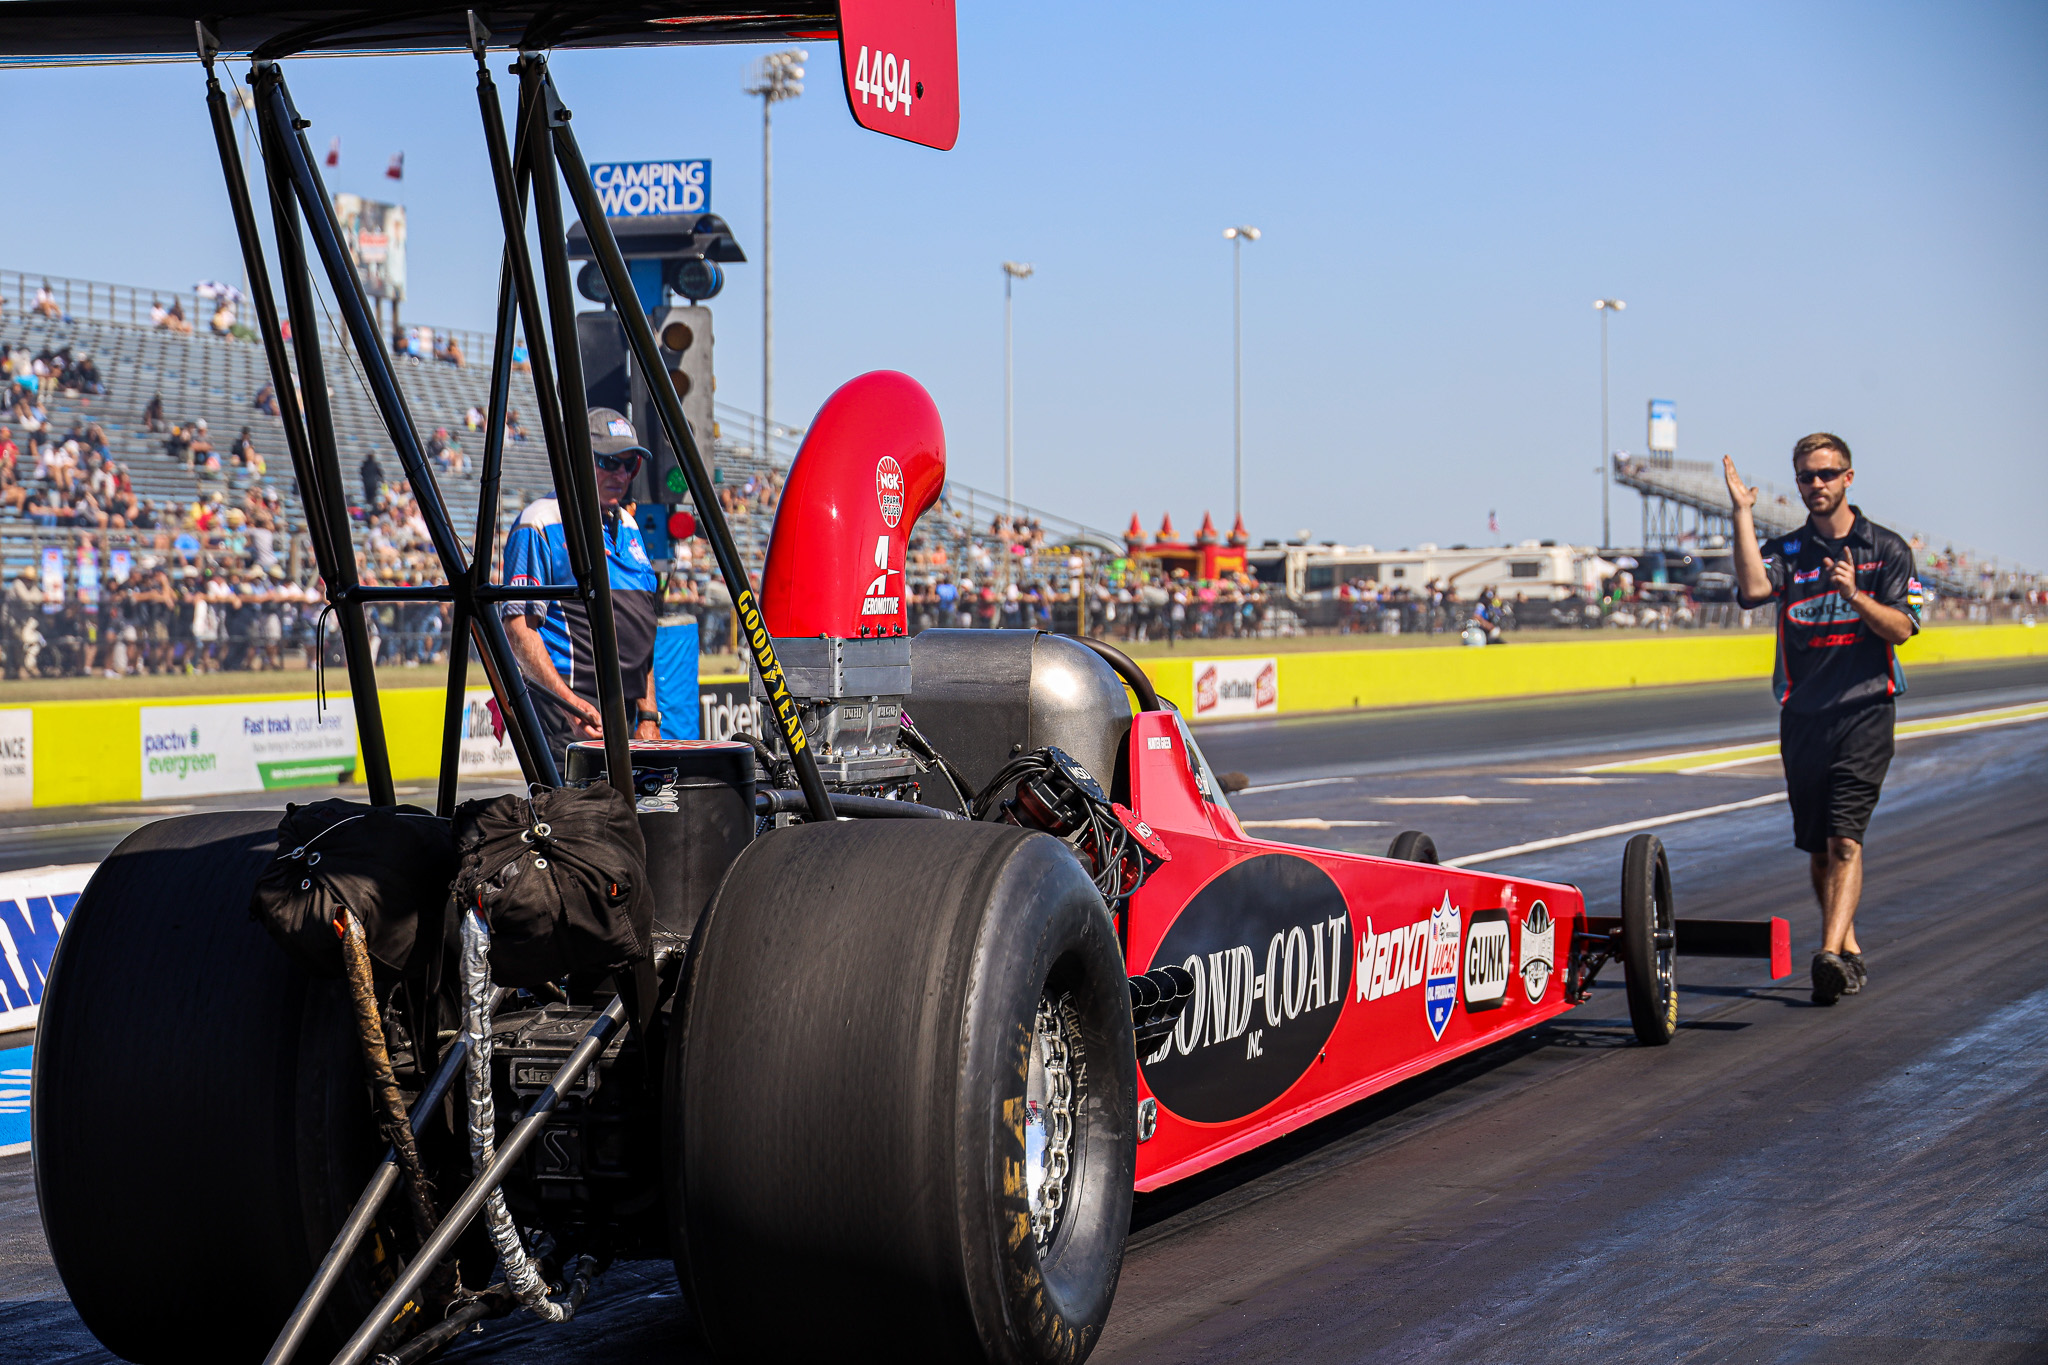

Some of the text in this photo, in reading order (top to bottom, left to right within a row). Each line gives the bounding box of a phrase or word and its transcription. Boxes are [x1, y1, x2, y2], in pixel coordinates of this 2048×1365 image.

[854, 45, 913, 117] 4494
[593, 161, 706, 189] CAMPING
[595, 184, 706, 215] WORLD
[880, 471, 900, 491] NGK
[883, 494, 900, 505] SPARK
[884, 505, 900, 517] PLUGS
[861, 596, 900, 616] AEROMOTIVE
[738, 589, 807, 755] GOODYEAR
[243, 715, 266, 735] Fast
[267, 712, 292, 732] track
[144, 729, 187, 757] pactiv
[149, 752, 217, 779] evergreen
[1067, 766, 1092, 780] MSD
[1134, 821, 1153, 840] MSD
[1369, 919, 1430, 1002] BOXO
[1431, 942, 1458, 976] LUCAS
[1469, 934, 1506, 986] GUNK
[1145, 910, 1347, 1066] OND-COAT
[517, 1067, 585, 1085] Strae
